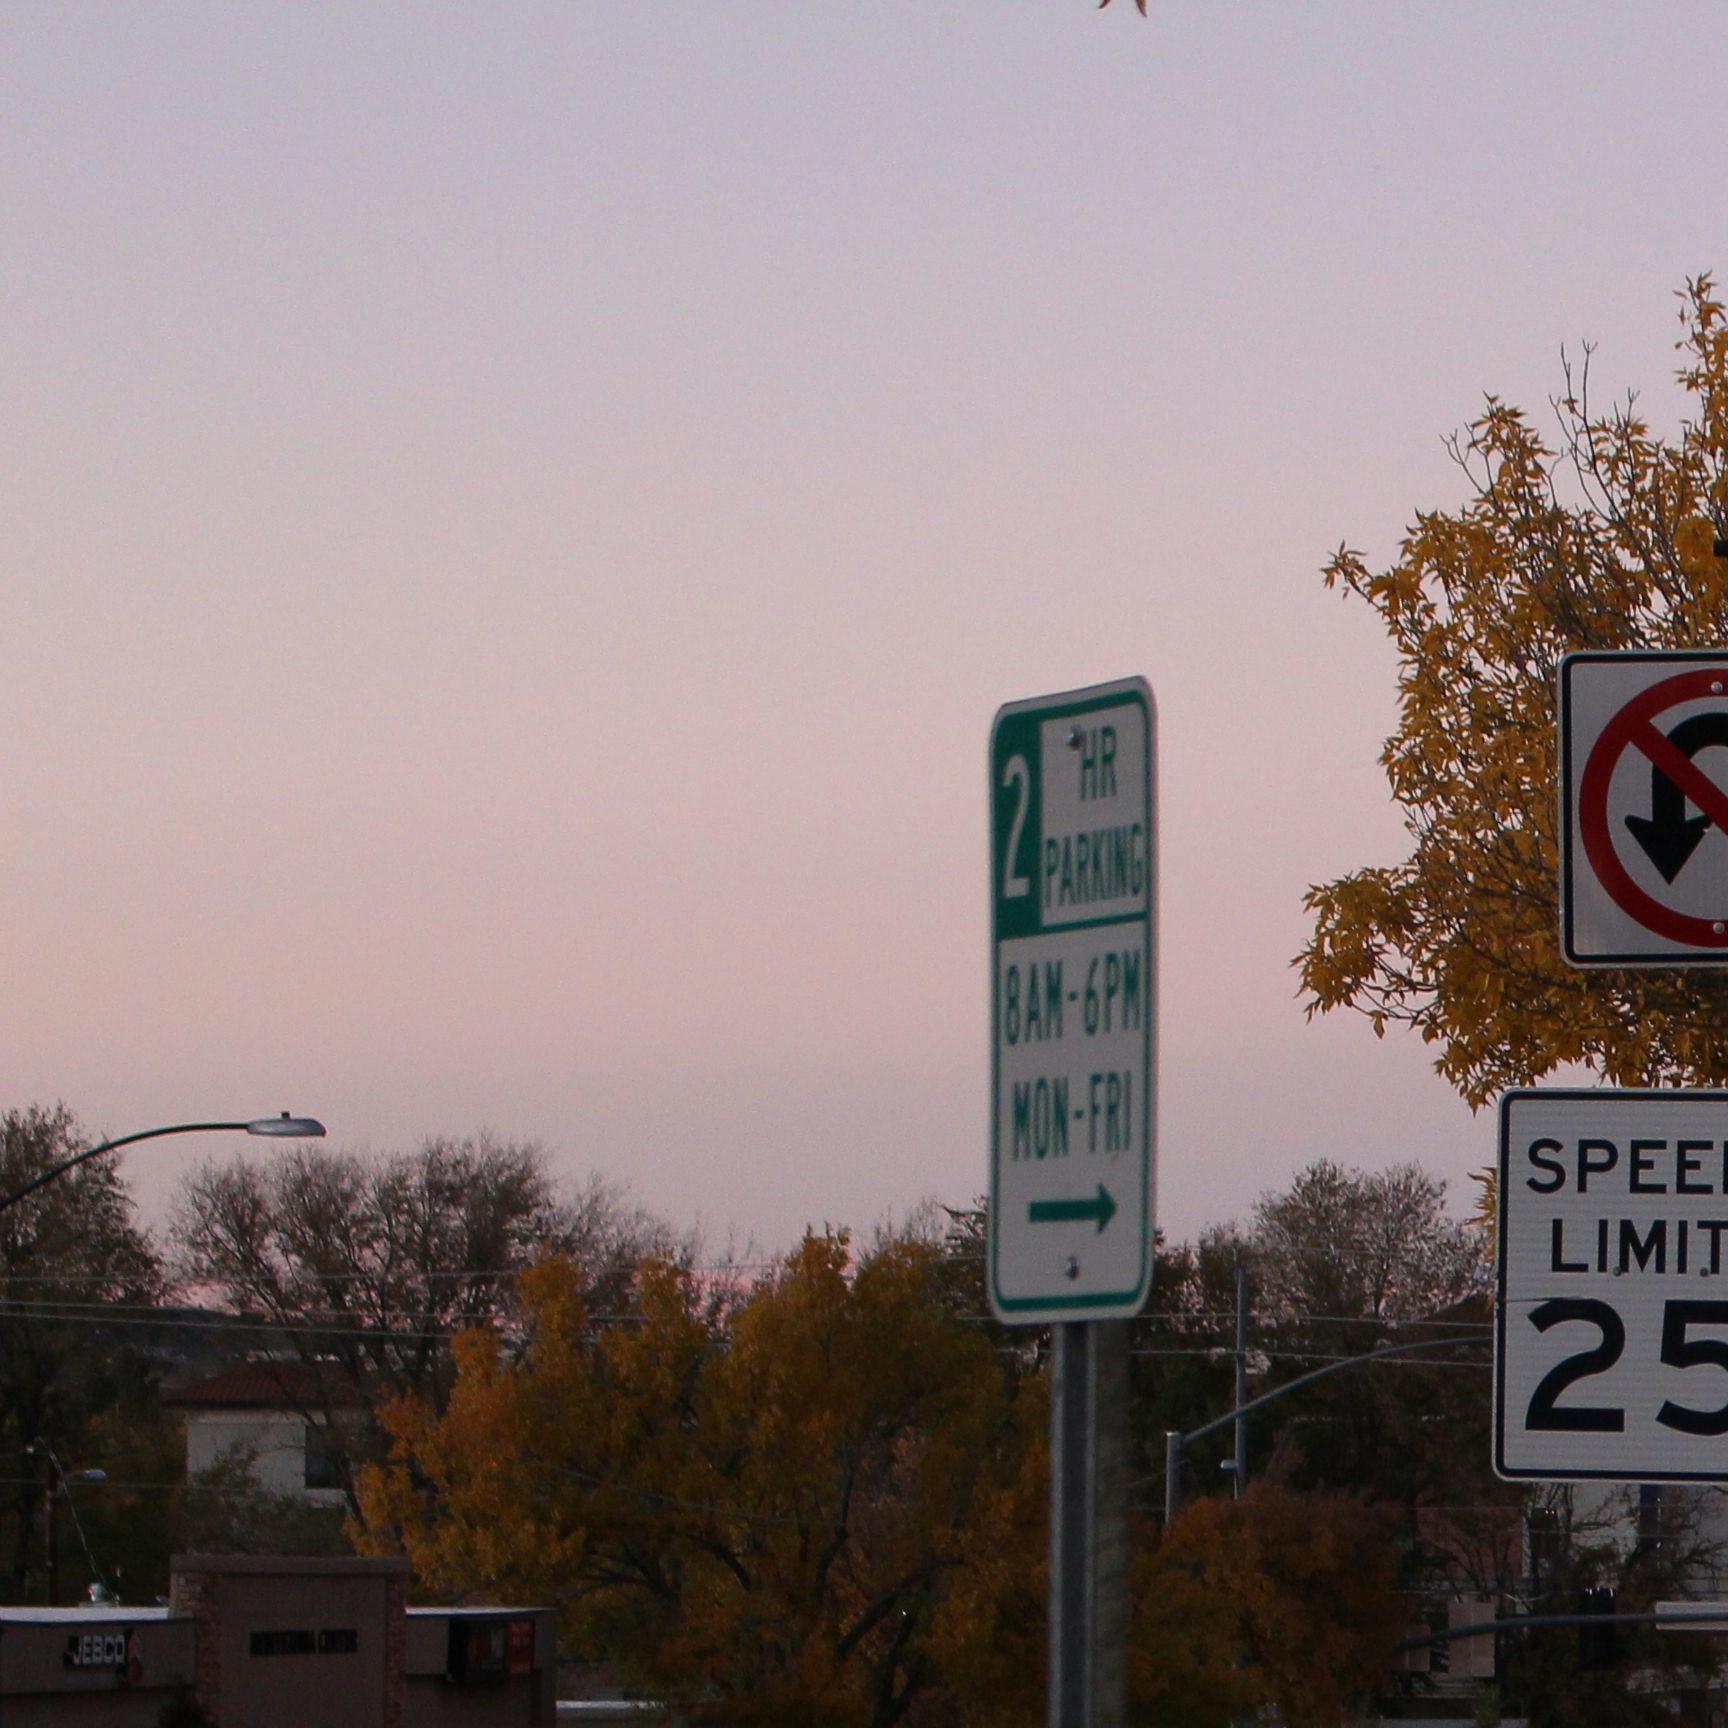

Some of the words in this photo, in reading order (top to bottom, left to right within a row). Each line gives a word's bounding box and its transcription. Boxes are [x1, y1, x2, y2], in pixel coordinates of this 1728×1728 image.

[1002, 753, 1031, 899] 2
[1078, 725, 1116, 802] HR
[1045, 824, 1145, 909] PARKING
[1006, 948, 1140, 1048] 8AM-6PM
[1012, 1070, 1131, 1162] MON-FRI
